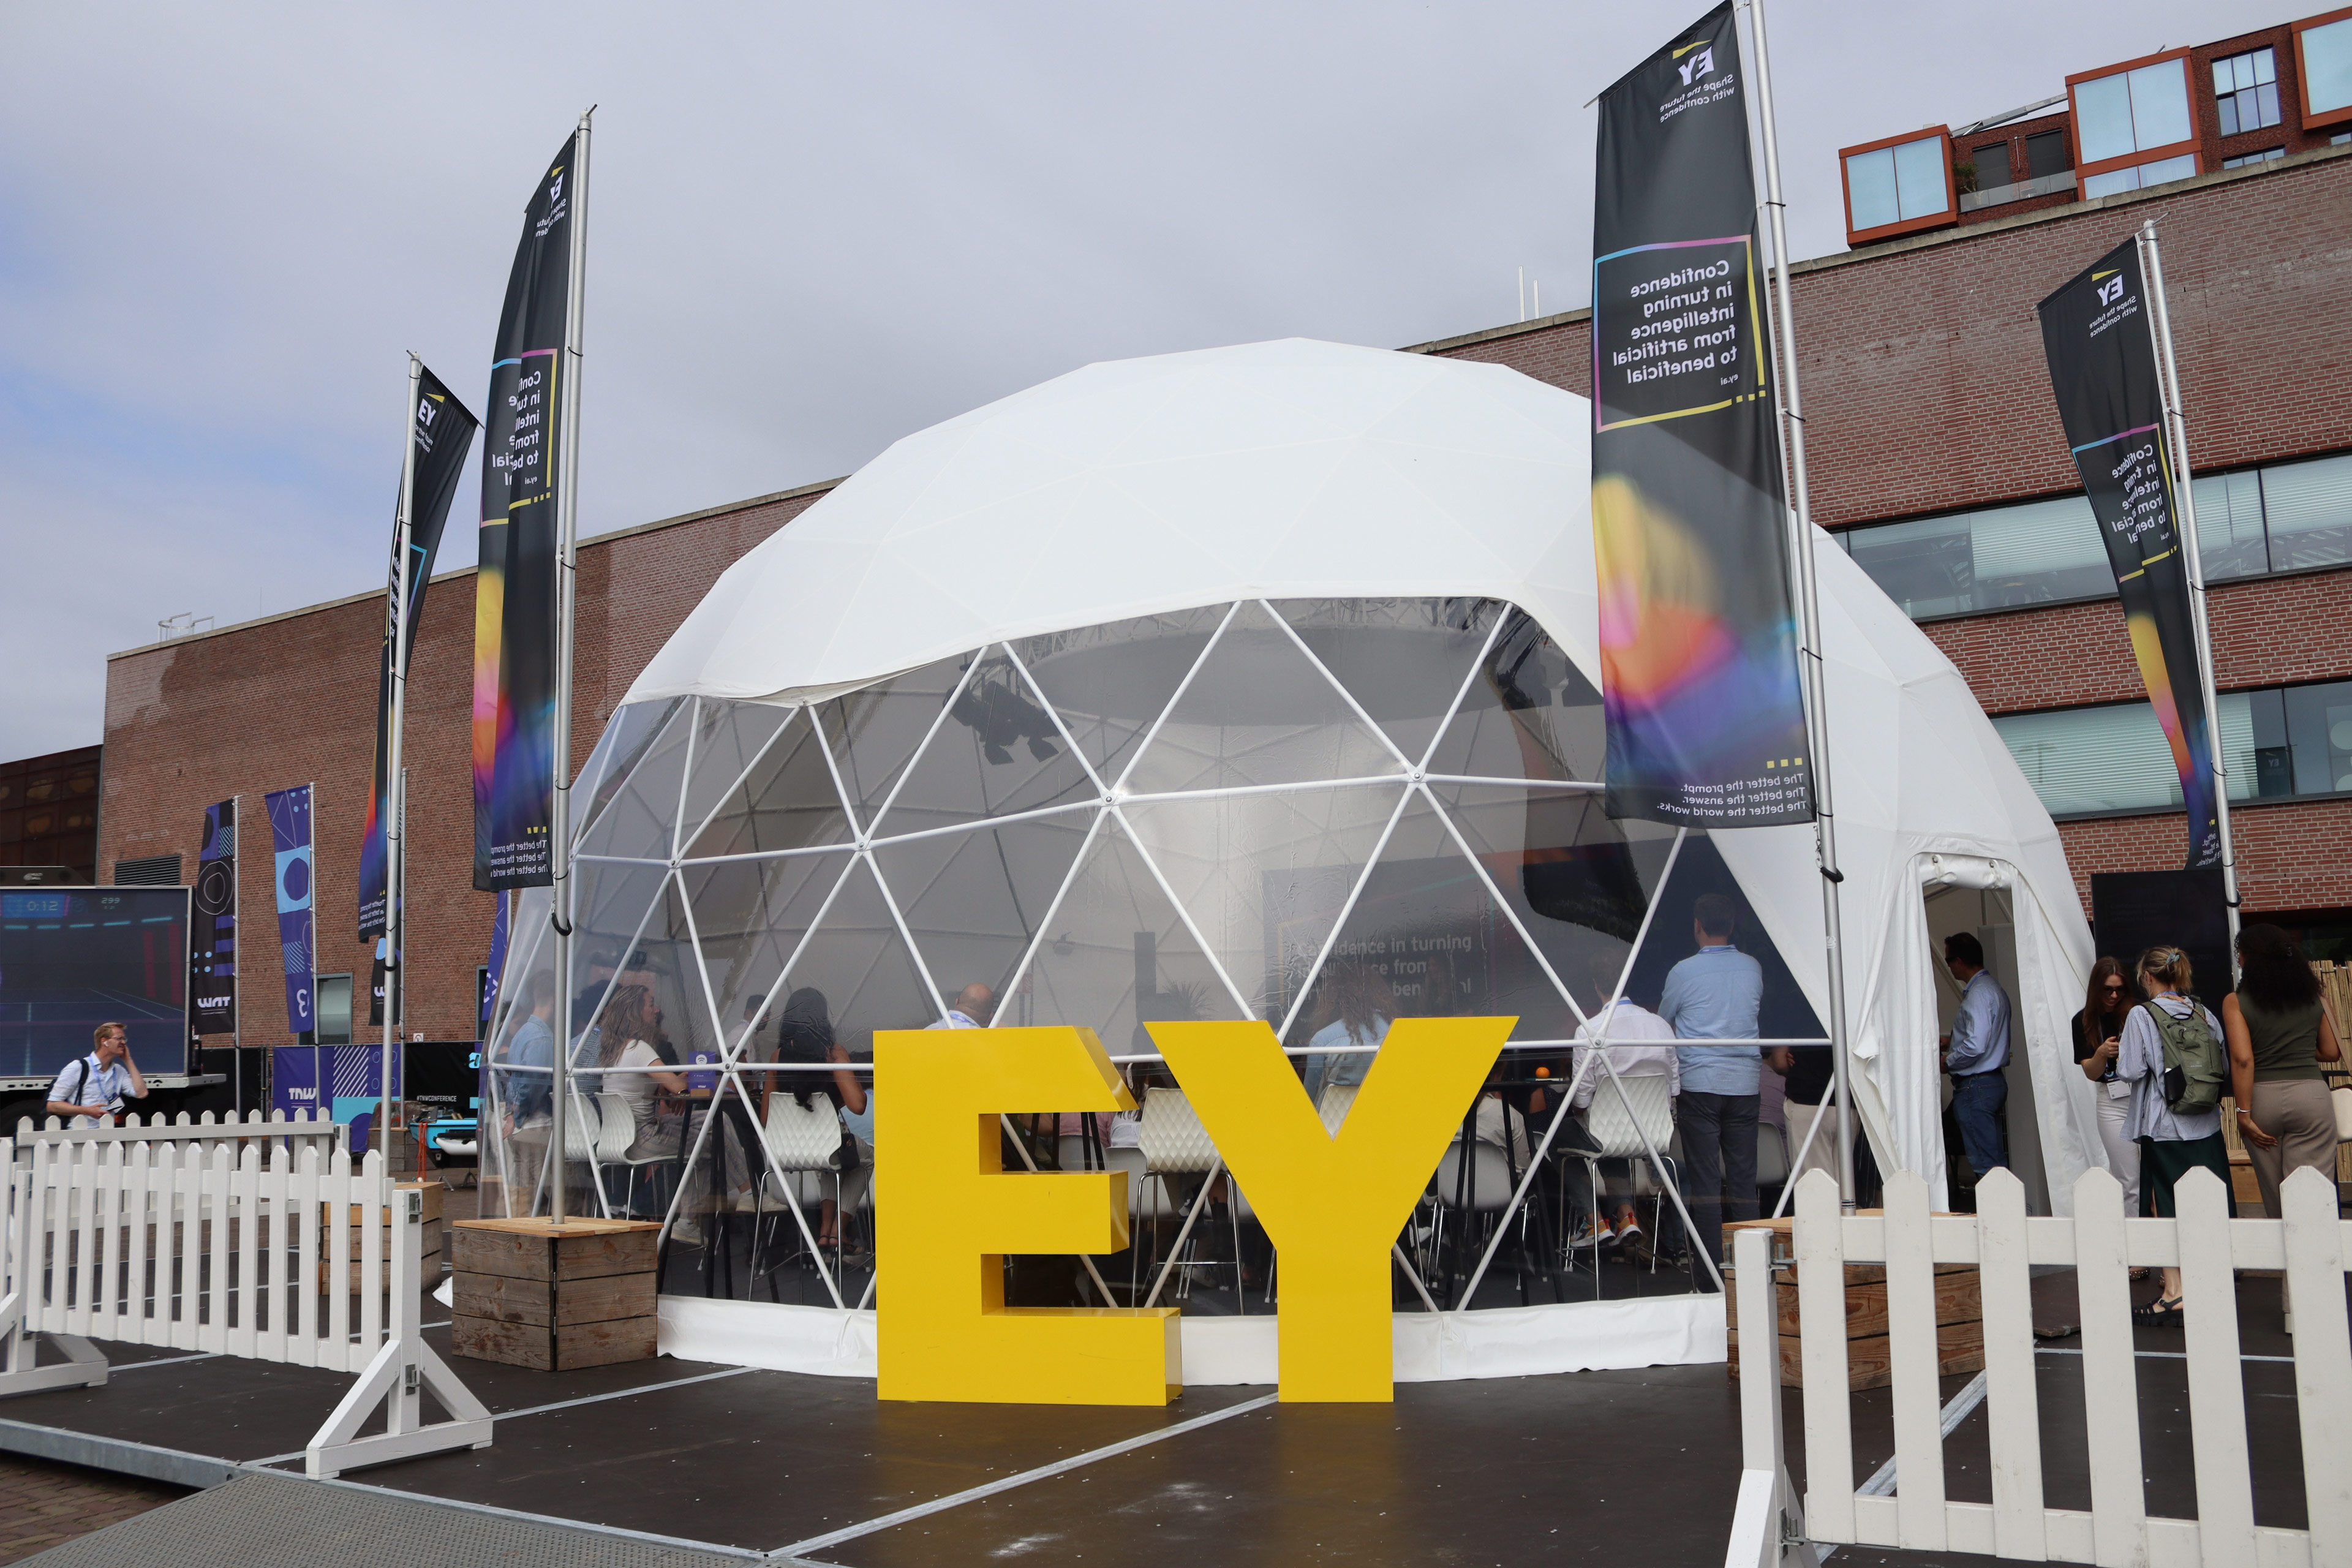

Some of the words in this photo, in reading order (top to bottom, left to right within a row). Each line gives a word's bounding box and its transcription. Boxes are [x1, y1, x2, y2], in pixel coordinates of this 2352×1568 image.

[418, 398, 437, 426] EY
[1391, 937, 1406, 953] in
[1411, 934, 1471, 952] turning
[288, 1087, 317, 1100] TNW
[873, 1016, 1520, 1407] EY
